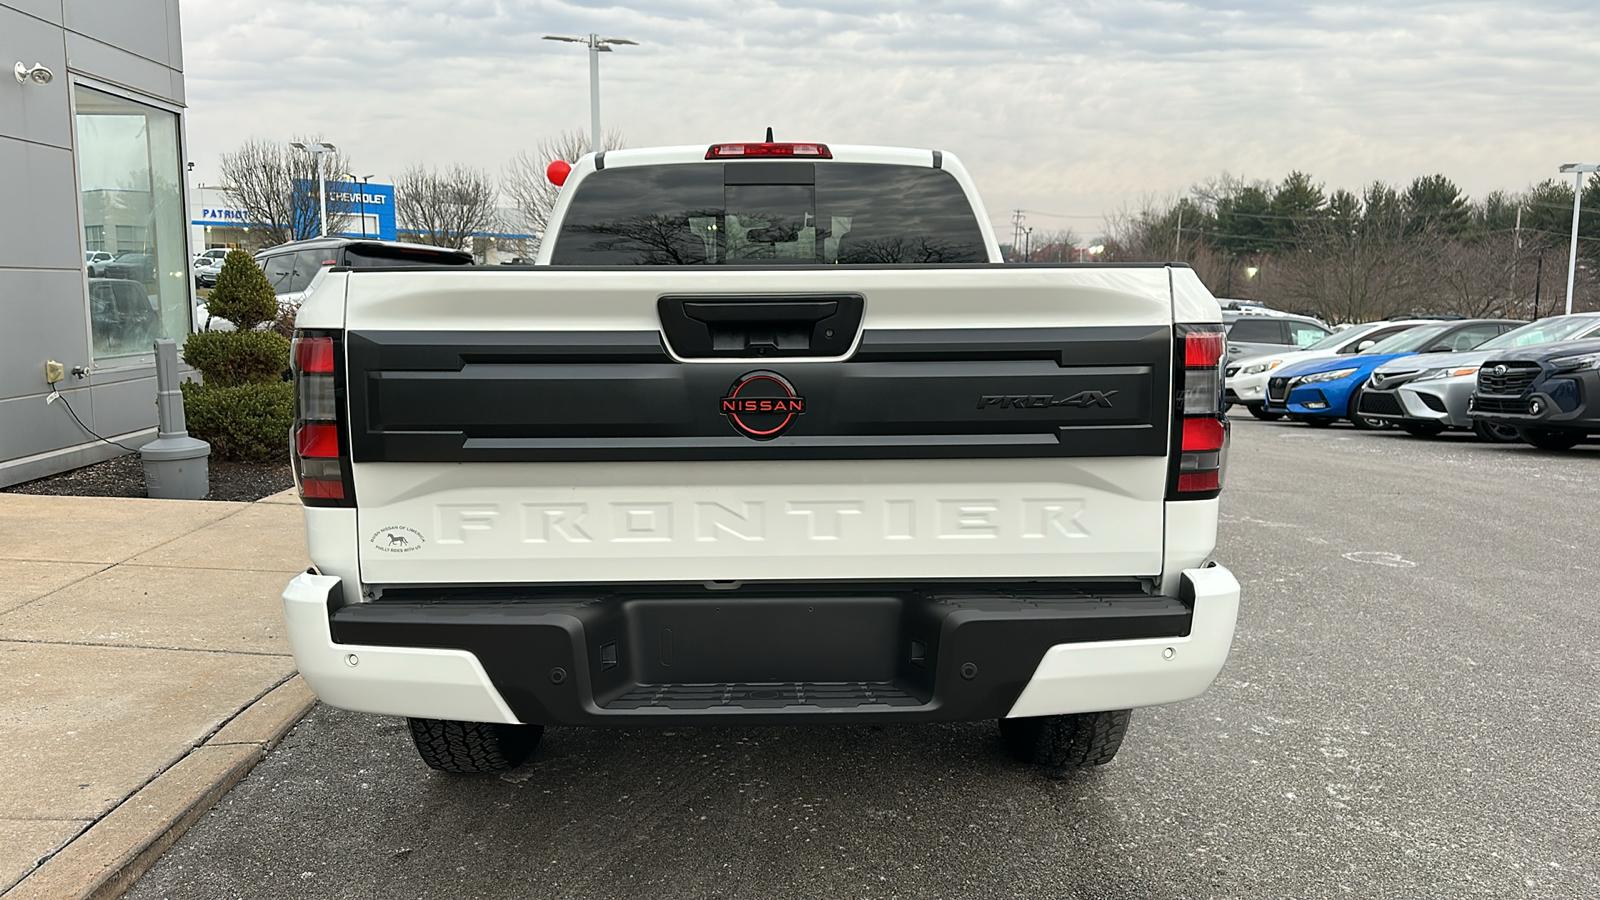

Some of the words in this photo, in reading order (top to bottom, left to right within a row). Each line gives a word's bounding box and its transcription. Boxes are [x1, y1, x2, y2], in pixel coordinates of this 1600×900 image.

[329, 191, 387, 206] CHEVROLET
[202, 208, 249, 220] PATRIOT
[722, 399, 803, 412] NISSAN
[976, 388, 1119, 410] PRO-4X
[380, 525, 398, 533] NISSAN
[433, 498, 1093, 546] FRONTIER
